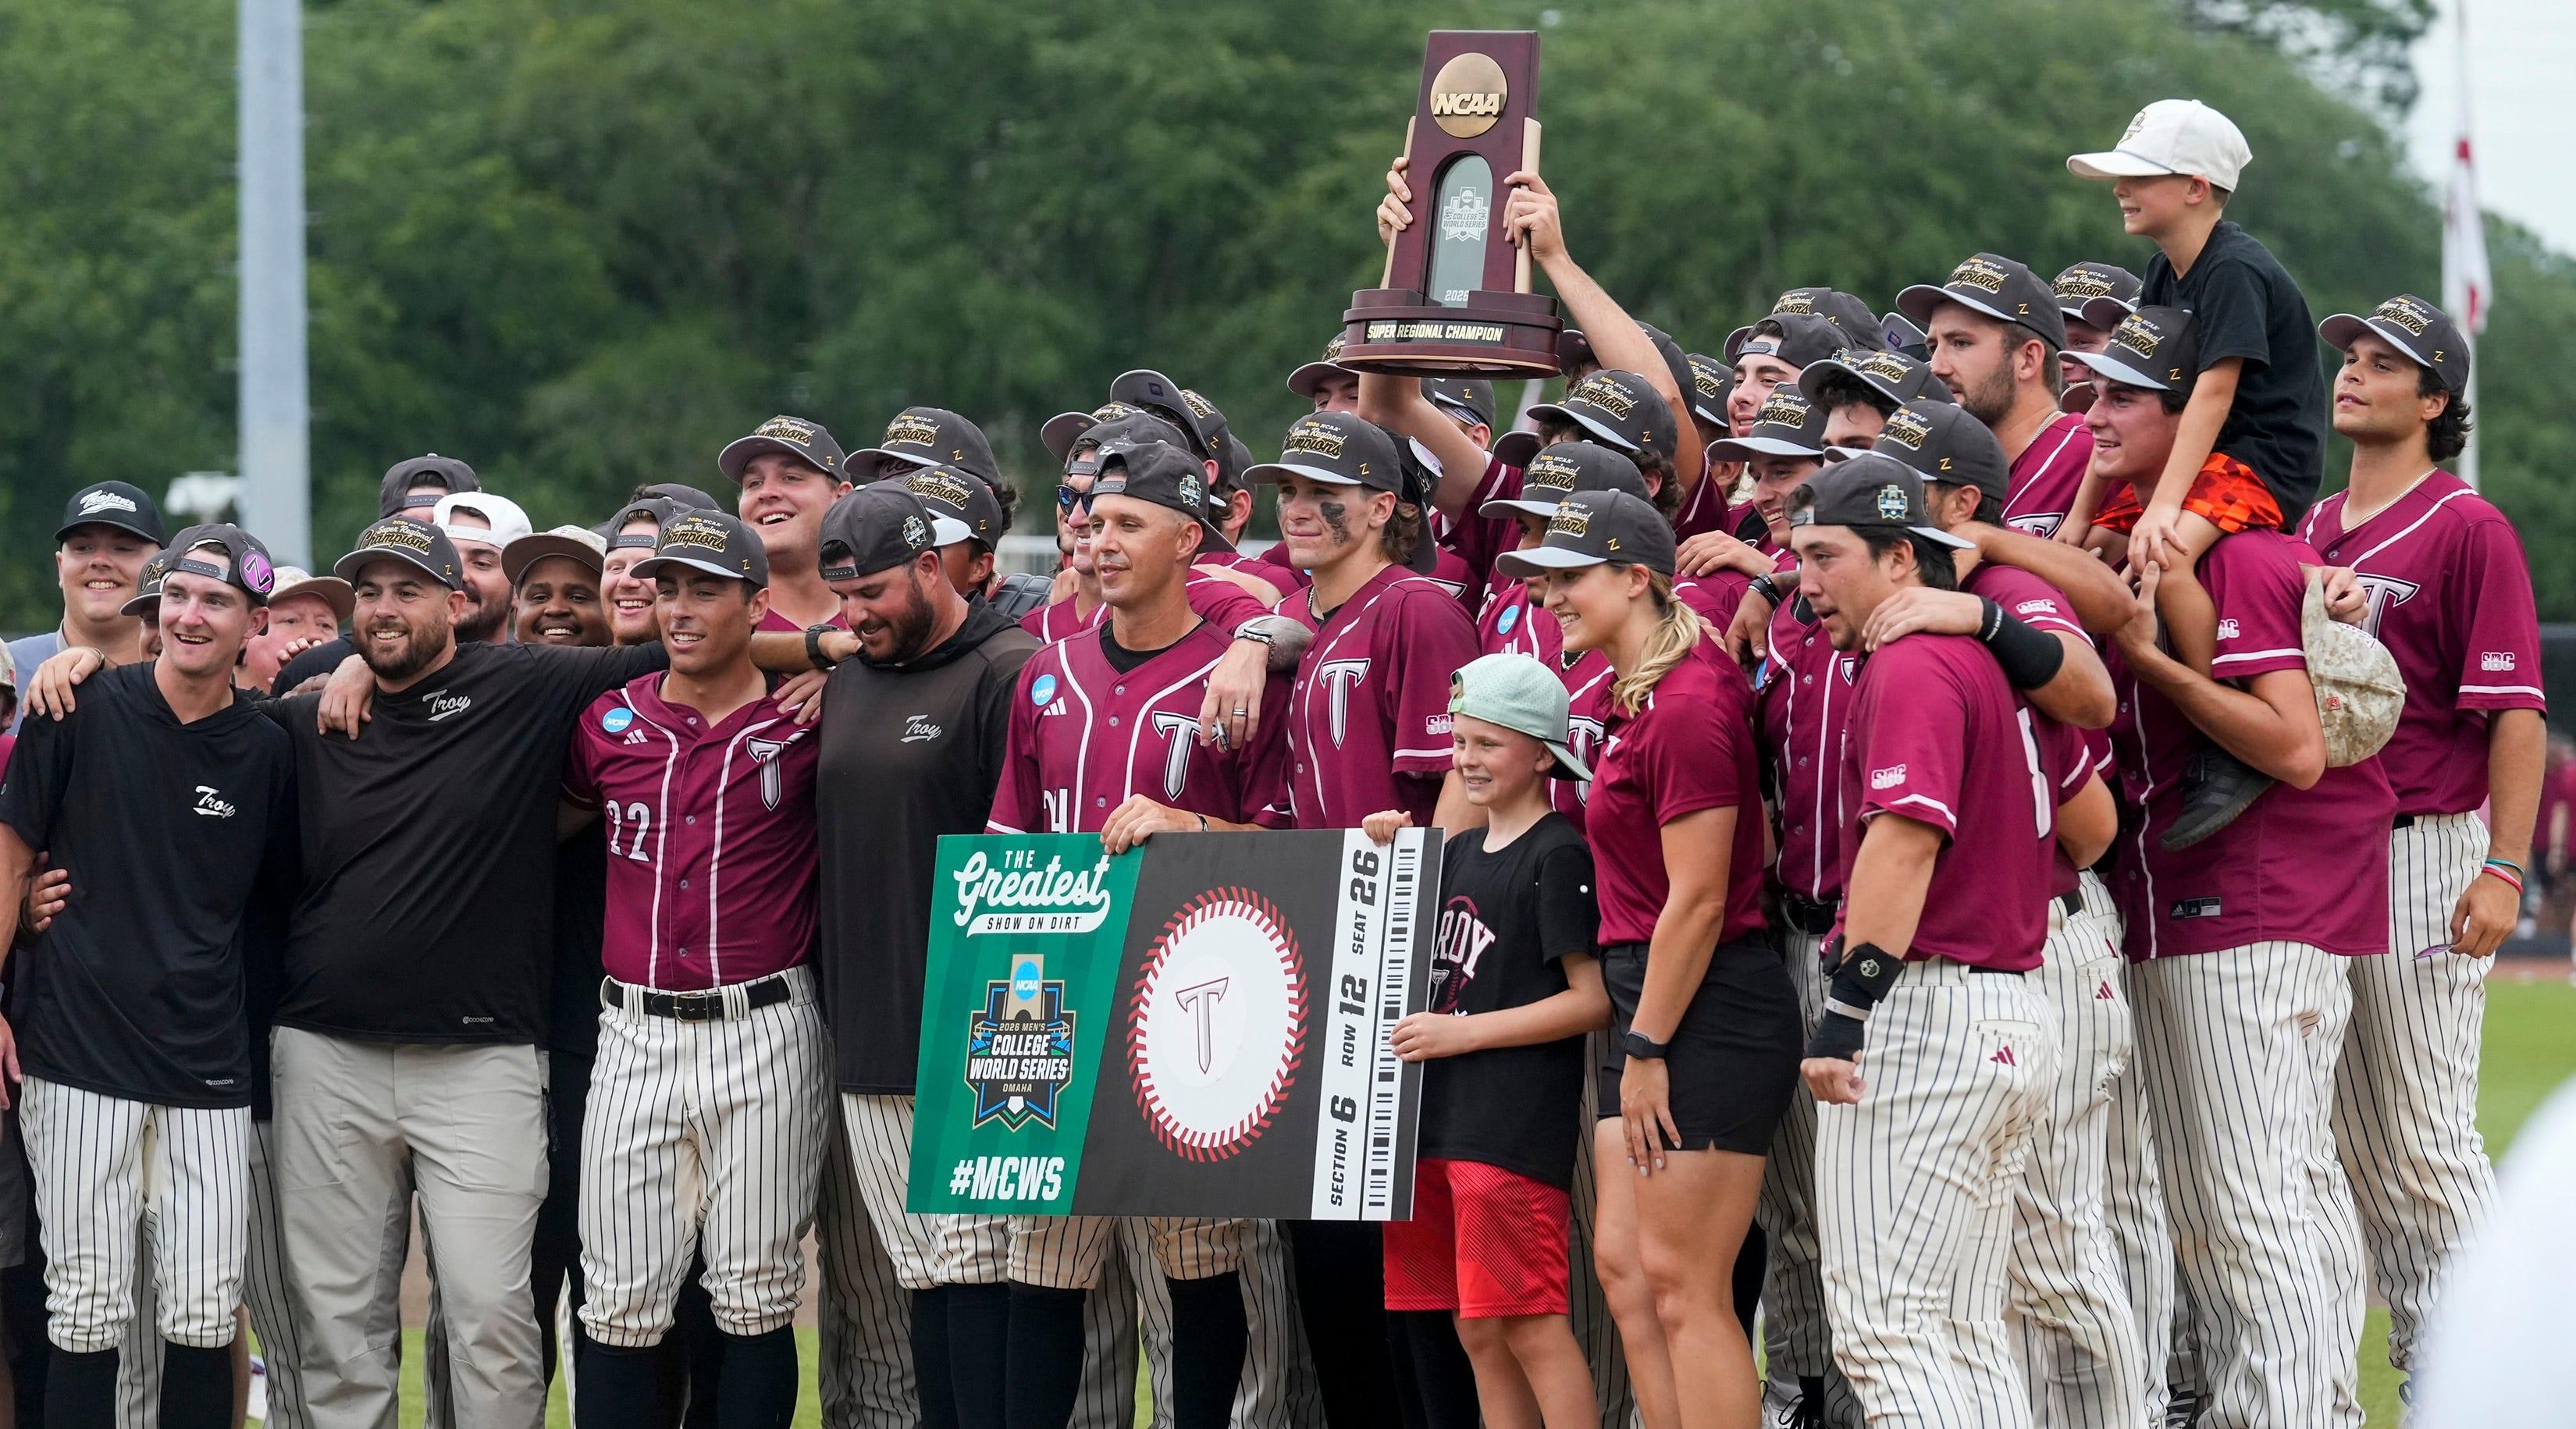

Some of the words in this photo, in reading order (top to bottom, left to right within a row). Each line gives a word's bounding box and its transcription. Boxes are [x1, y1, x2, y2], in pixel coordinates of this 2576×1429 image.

[1434, 92, 1503, 116] NCAA
[1972, 264, 2009, 281] Regional
[2078, 275, 2115, 290] Regional
[2397, 304, 2434, 326] Regional
[1367, 325, 1396, 339] SUPER
[1397, 324, 1443, 339] REGIONAL
[1445, 325, 1503, 342] CHAMPION
[1600, 376, 1614, 386] 2026
[1603, 384, 1638, 408] Regional
[1774, 399, 1811, 414] Regional
[780, 421, 816, 436] Regional
[906, 421, 941, 433] Regional
[1310, 427, 1348, 443] Regional
[1360, 463, 1370, 475] Z
[1544, 460, 1581, 475] Regional
[1940, 457, 1952, 470] Z
[916, 474, 938, 484] Super
[938, 477, 973, 498] Regional
[949, 475, 967, 485] NCAA
[377, 525, 399, 535] Super
[399, 525, 435, 544] Regional
[673, 523, 695, 534] Super
[694, 522, 730, 539] Regional
[360, 529, 431, 553] Champions
[1607, 538, 1621, 551] Z
[2481, 652, 2515, 671] SBC
[422, 689, 471, 716] Troy
[903, 714, 942, 742] Troy
[194, 785, 236, 819] Troy
[606, 799, 650, 862] 22
[1005, 850, 1035, 869] THE
[1350, 849, 1380, 907] 26
[953, 851, 1110, 926] Greatest
[987, 917, 1022, 930] SHOW
[1028, 917, 1044, 930] ON
[1050, 916, 1080, 930] DIRT
[1351, 910, 1367, 955] SEAT
[1433, 910, 1496, 979] ROY
[1016, 980, 1038, 991] NCAA
[1339, 974, 1368, 1017] 12
[999, 1023, 1019, 1032] 2026
[1022, 1023, 1046, 1032] MEN'S
[991, 1034, 1051, 1056] COLLEGE
[1342, 1024, 1357, 1067] ROW
[970, 1058, 1019, 1079] WORLD
[1019, 1058, 1069, 1080] SERIES
[1002, 1083, 1032, 1093] OMAHA
[1330, 1094, 1357, 1124] 6
[1330, 1129, 1348, 1207] SECTION
[948, 1156, 1063, 1202] #MCWS
